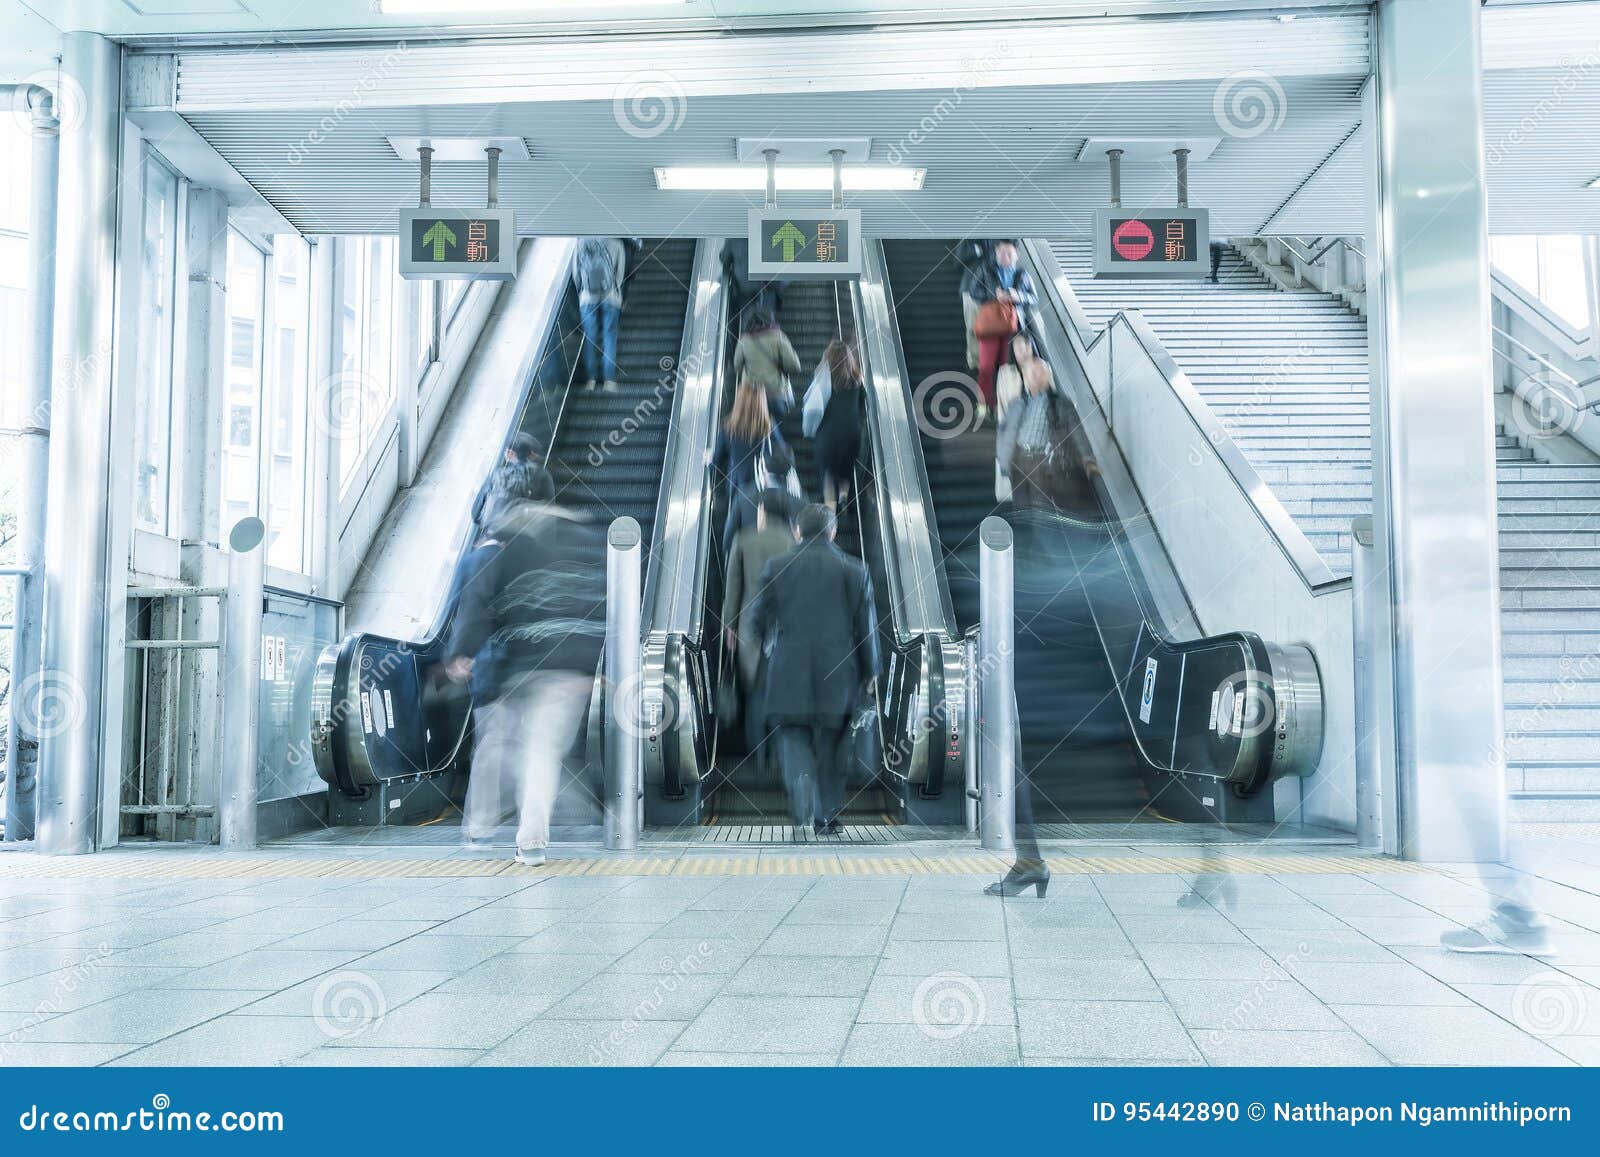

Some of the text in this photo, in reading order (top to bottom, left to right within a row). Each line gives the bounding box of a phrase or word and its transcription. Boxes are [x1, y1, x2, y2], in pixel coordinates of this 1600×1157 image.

[468, 221, 488, 262] 自動
[817, 221, 837, 262] 自動
[1165, 220, 1186, 261] 自動
